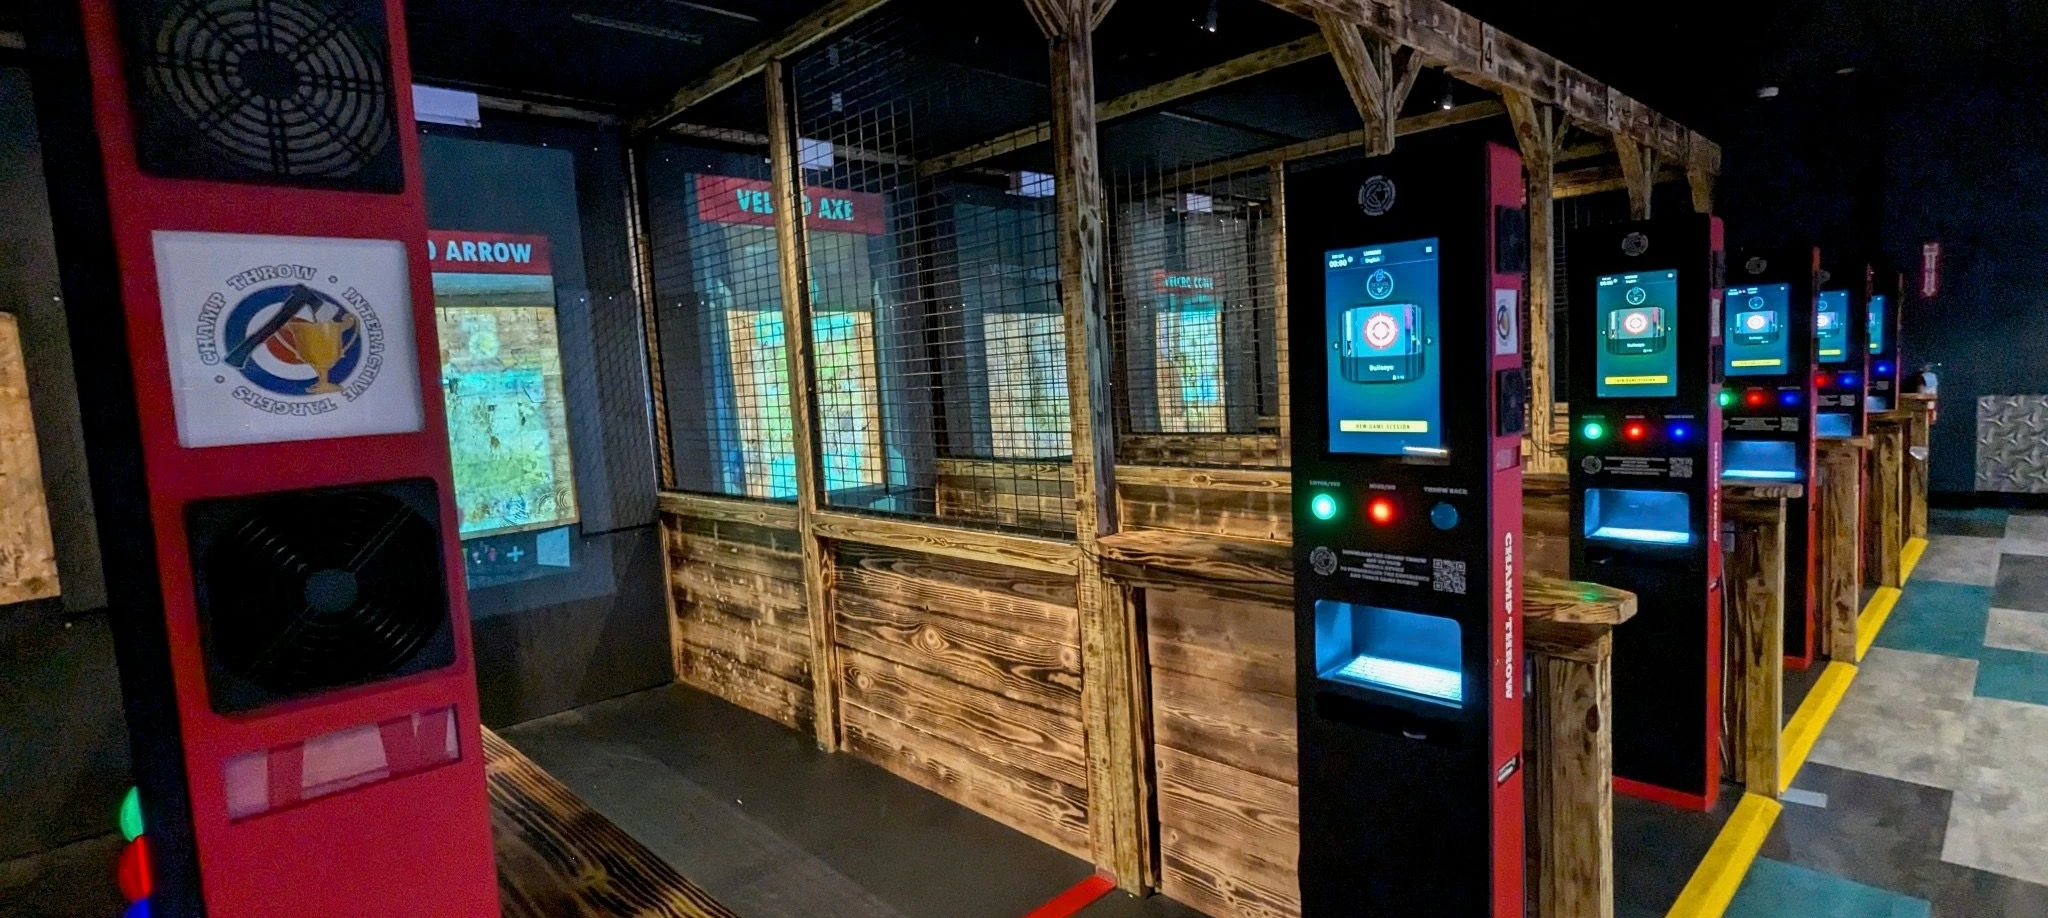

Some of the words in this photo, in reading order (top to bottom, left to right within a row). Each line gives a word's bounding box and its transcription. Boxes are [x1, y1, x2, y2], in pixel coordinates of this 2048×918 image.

[1485, 40, 1492, 69] 4
[736, 189, 812, 216] VELO
[818, 198, 854, 221] AXE
[446, 240, 532, 263] ARROW
[225, 264, 317, 292] THROW
[196, 291, 227, 366] CHAMP
[341, 286, 385, 403] INTERACTIVE
[231, 385, 339, 417] TARGETS
[1504, 532, 1513, 614] CHAMP
[1504, 616, 1513, 699] THROW
